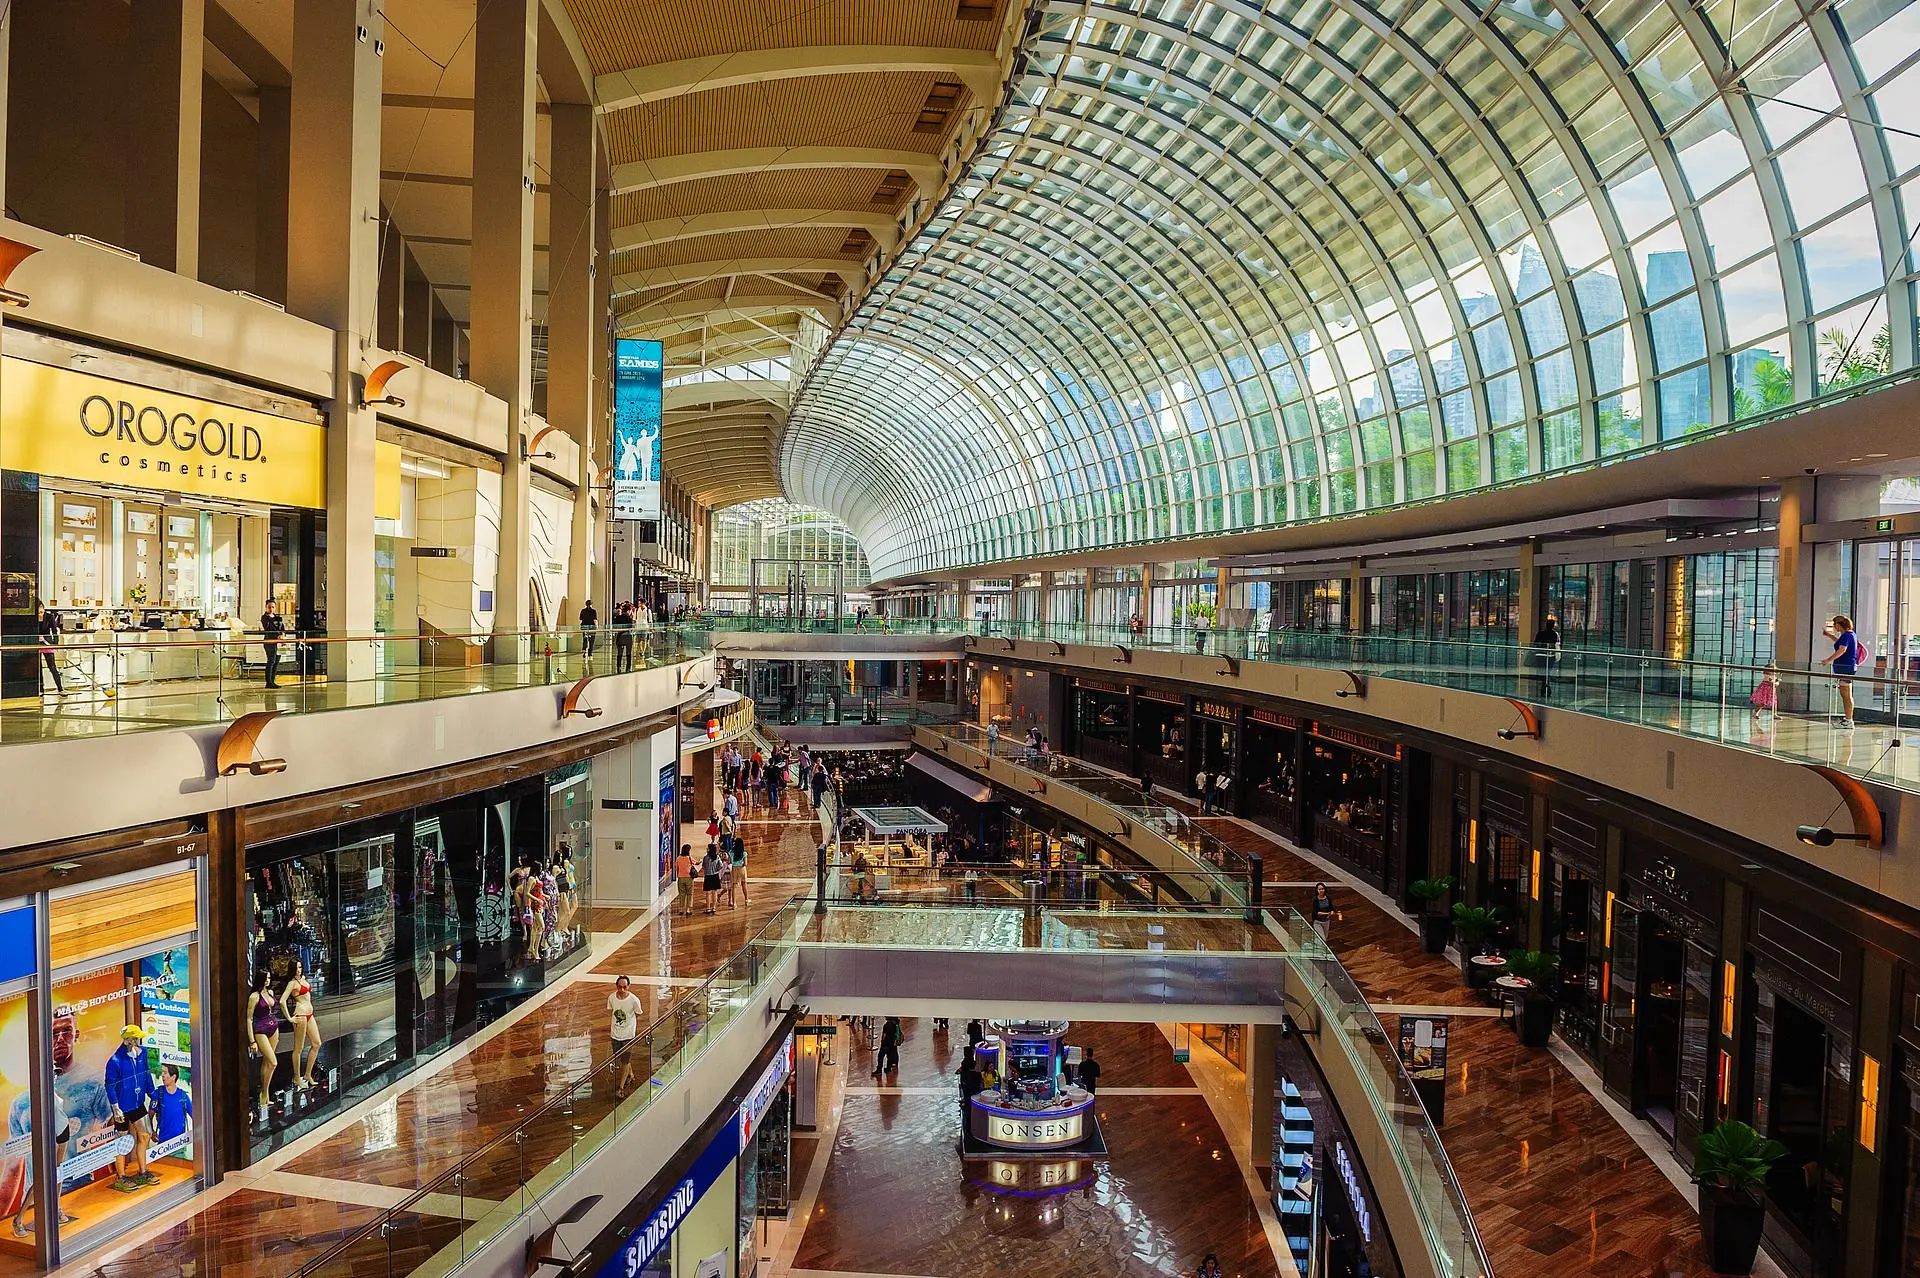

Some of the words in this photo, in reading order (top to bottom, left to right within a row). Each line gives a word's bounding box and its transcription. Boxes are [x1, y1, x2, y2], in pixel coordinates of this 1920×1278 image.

[619, 359, 659, 368] EAMES
[99, 451, 248, 483] cosmetics
[177, 843, 196, 854] B1-67
[57, 1000, 88, 1016] MAKES
[89, 994, 107, 1007] HOT
[1001, 1122, 1069, 1137] ONSEN
[157, 1136, 190, 1157] Columbia
[625, 1178, 694, 1278] SAMSUNG
